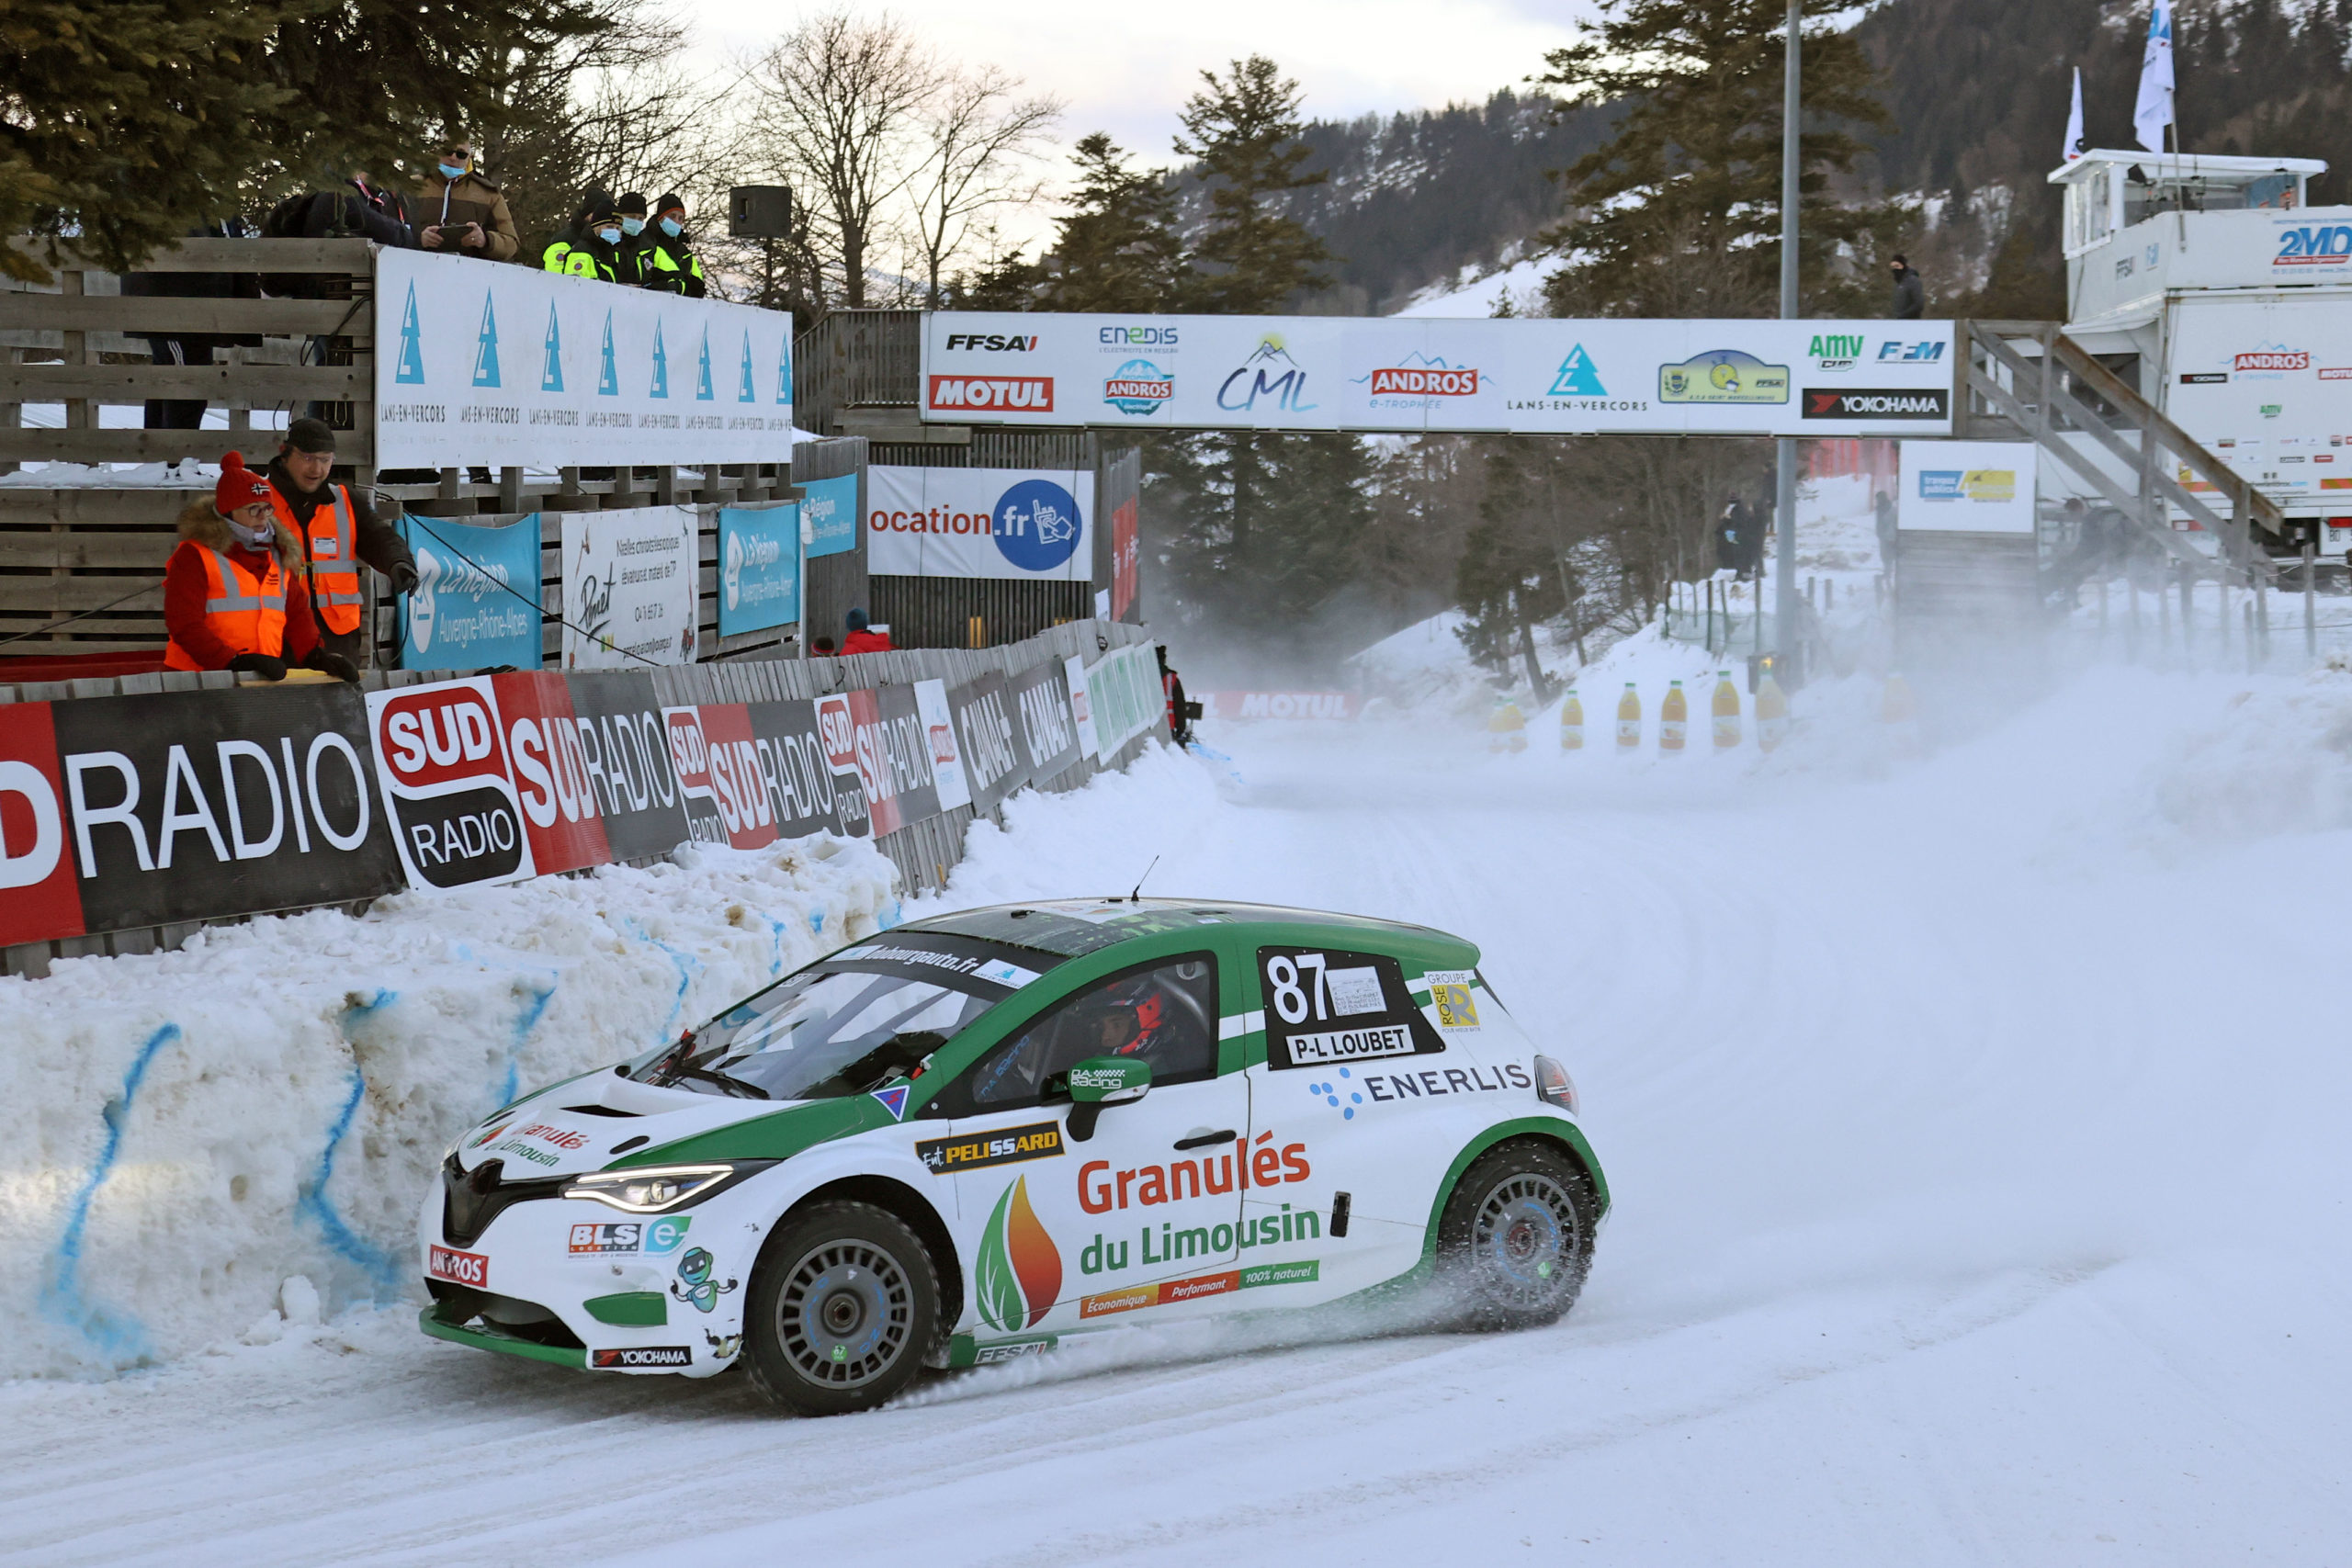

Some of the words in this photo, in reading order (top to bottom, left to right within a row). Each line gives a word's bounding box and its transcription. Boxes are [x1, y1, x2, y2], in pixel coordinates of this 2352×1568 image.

[946, 334, 1027, 351] FFSA
[2236, 354, 2308, 369] ANDROS
[934, 380, 1049, 408] MOTUL
[1107, 382, 1170, 398] ANDROS
[1216, 367, 1320, 412] CML
[1374, 371, 1475, 394] ANDROS
[380, 404, 446, 423] LANS-EN-VERCORS
[529, 409, 579, 427] LANS-EN-VERCORS
[1507, 400, 1647, 411] LANS-EN-VERCORS
[1841, 396, 1939, 412] YOKOHAMA
[870, 504, 1030, 536] ocation.fr
[438, 556, 465, 594] La
[458, 554, 510, 604] Région
[439, 605, 528, 649] Auvergne-Rhône-Alpes
[1241, 694, 1348, 718] MOTUL
[388, 702, 492, 773] SUD
[822, 710, 853, 757] SUD
[671, 724, 707, 776] SUD
[837, 787, 867, 824] RADIO
[411, 808, 515, 868] RADIO
[865, 945, 980, 973] dubourgauto.fr
[1266, 953, 1328, 1025] 87
[1427, 973, 1468, 984] GROUPE
[1433, 987, 1453, 1025] ROSE
[1295, 1038, 1328, 1060] P-L
[1333, 1029, 1406, 1056] LOUBET
[1071, 1077, 1122, 1089] Racing
[1364, 1064, 1532, 1102] ENERLIS
[946, 1131, 1057, 1164] PELISSARD
[1077, 1129, 1310, 1215] Granulés
[571, 1224, 639, 1246] BLS
[1080, 1234, 1128, 1276] du
[1142, 1202, 1320, 1265] Limousin
[1087, 1297, 1148, 1314] Économique
[1171, 1279, 1227, 1298] Performant
[1246, 1270, 1271, 1284] 100%
[1272, 1265, 1312, 1281] naturel
[620, 1349, 687, 1365] YOKOHAMA
